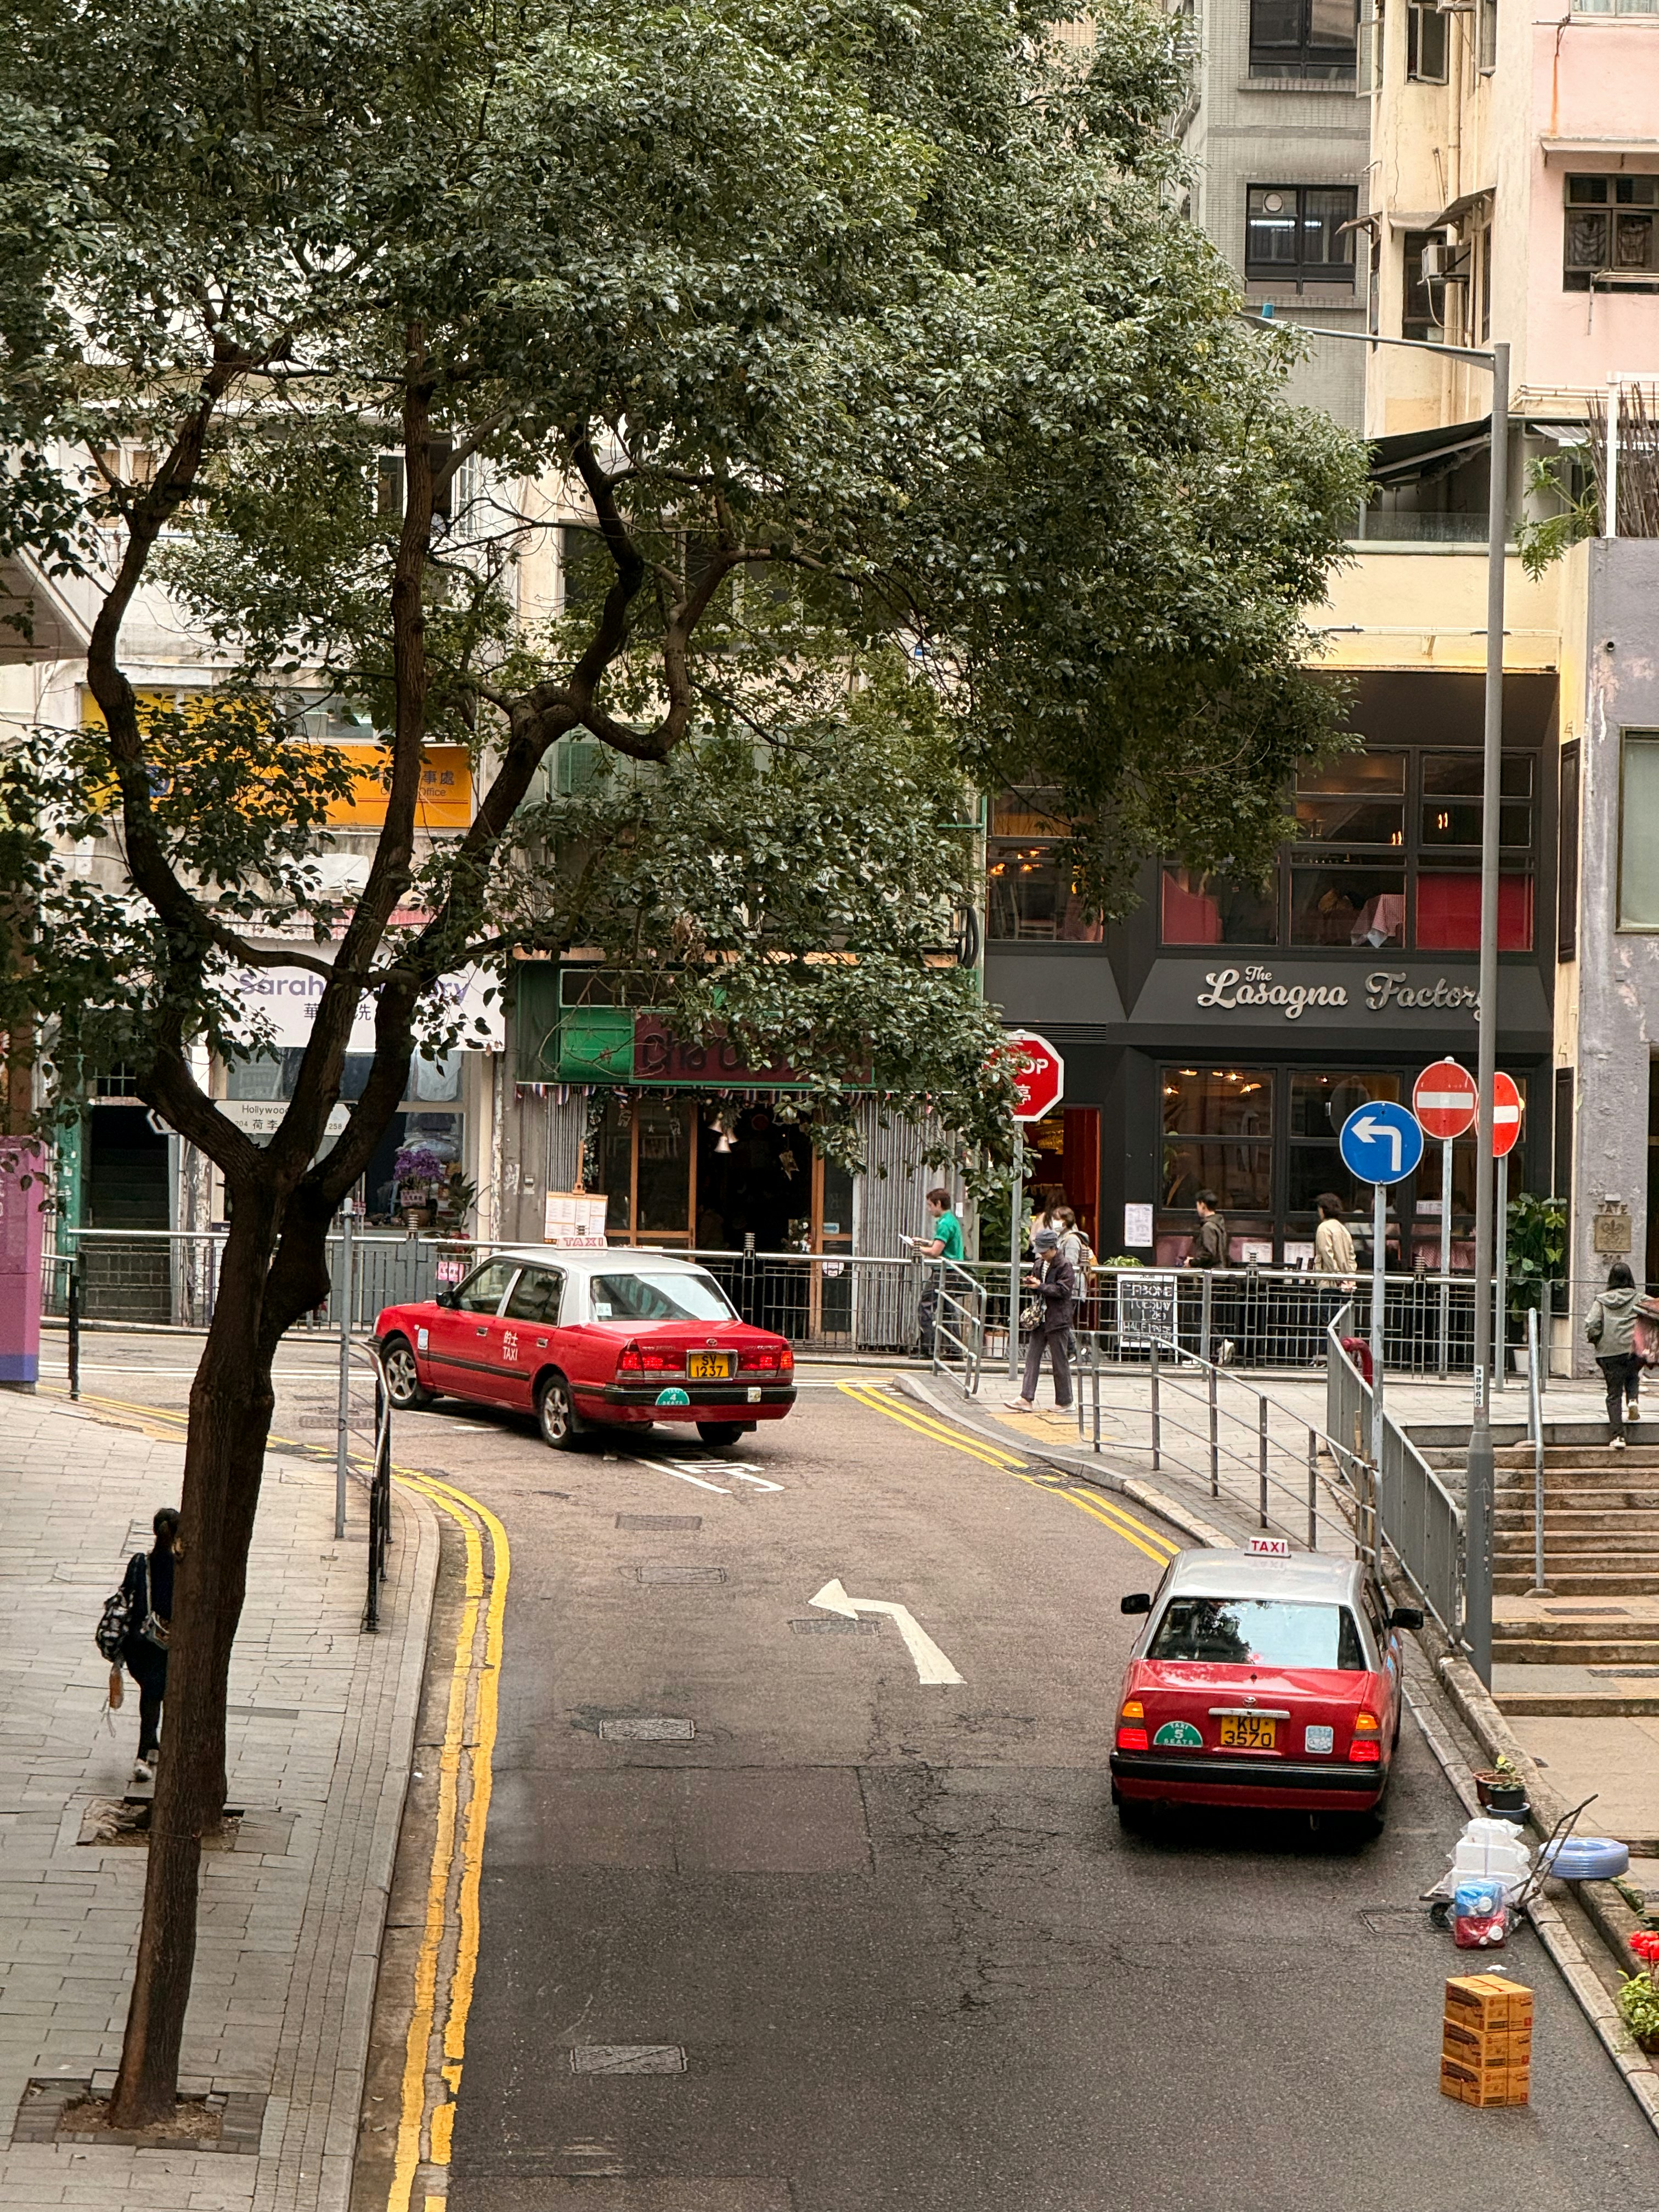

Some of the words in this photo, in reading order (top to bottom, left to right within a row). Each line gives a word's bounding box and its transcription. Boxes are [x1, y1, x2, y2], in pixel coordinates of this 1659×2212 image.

[1245, 966, 1272, 982] The
[1197, 968, 1348, 1019] Lasagna
[1007, 1058, 1049, 1075] OP
[1598, 1204, 1628, 1214] TATE
[563, 1237, 604, 1246] TAXI
[504, 1330, 518, 1347] 的士
[503, 1346, 518, 1361] TAXI
[702, 1356, 716, 1366] SV
[696, 1365, 724, 1377] 1237
[1251, 1540, 1285, 1554] TAXI
[1237, 1717, 1261, 1732] KU
[1174, 1729, 1184, 1739] 5
[1223, 1730, 1272, 1747] 3570
